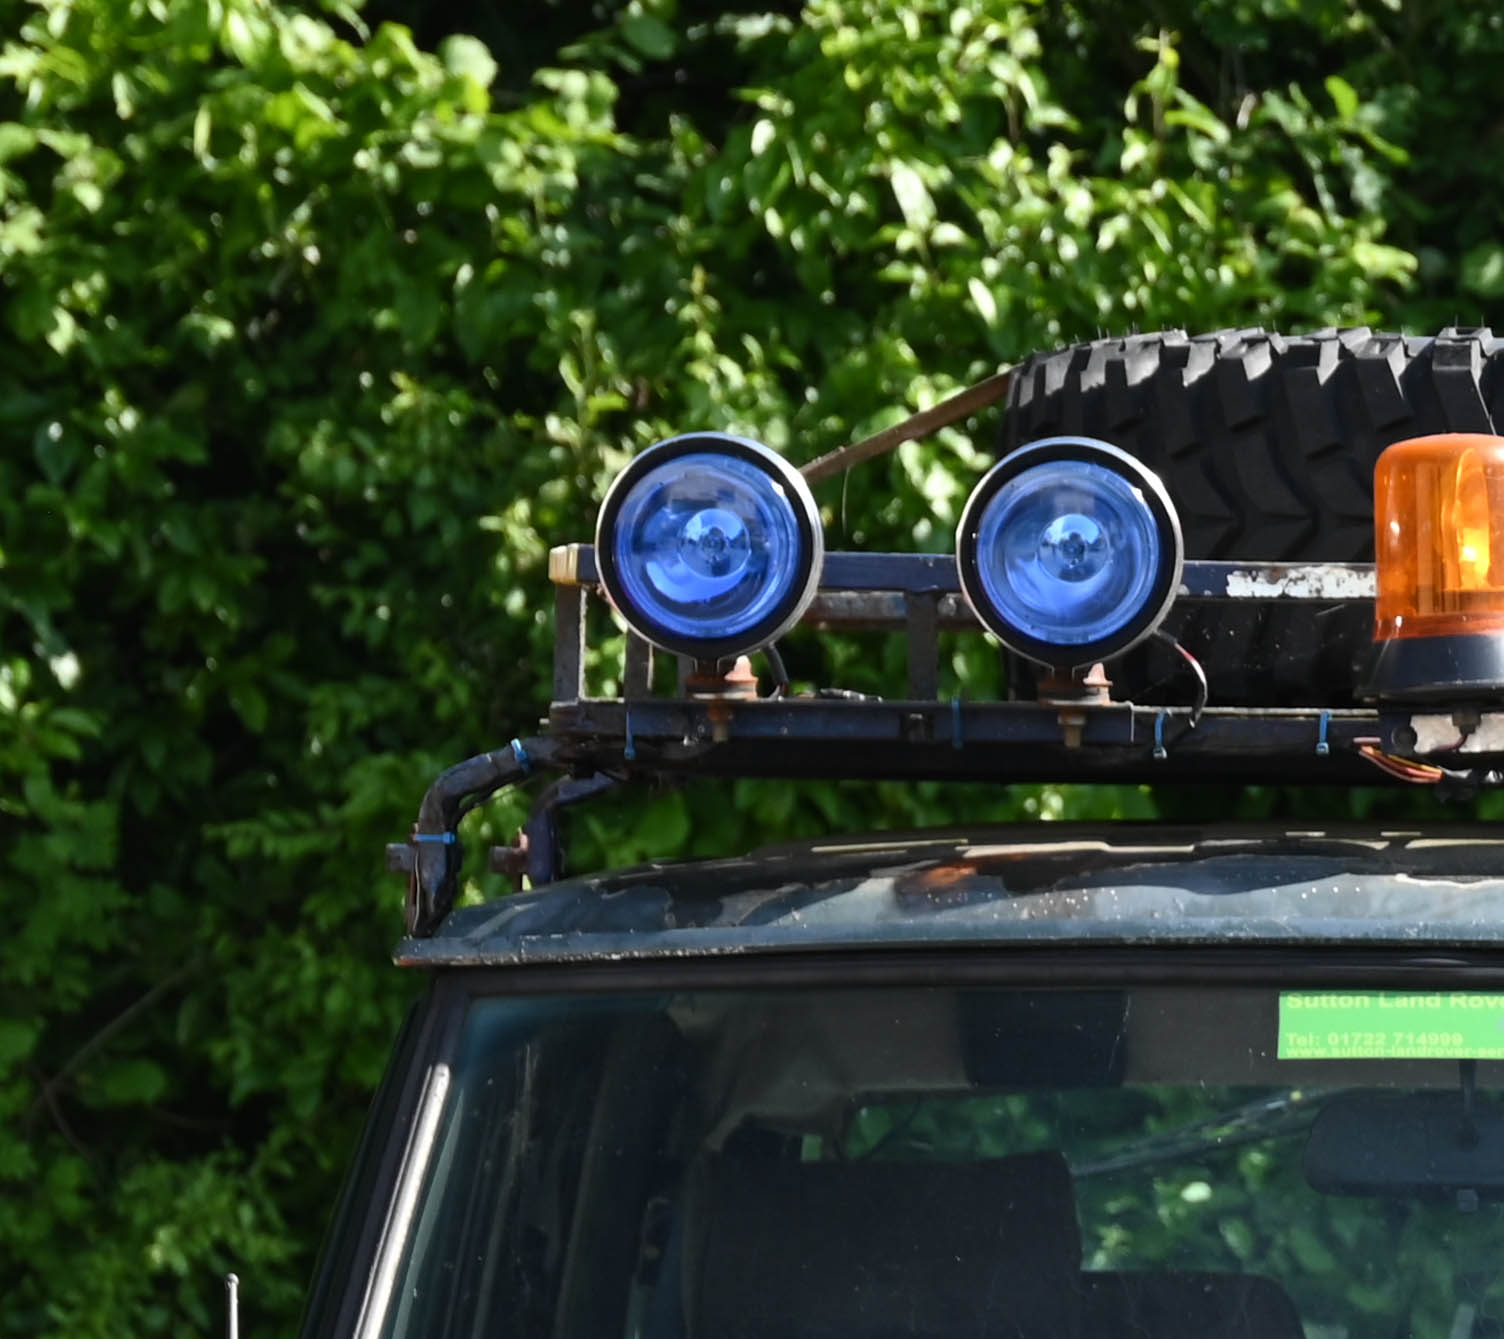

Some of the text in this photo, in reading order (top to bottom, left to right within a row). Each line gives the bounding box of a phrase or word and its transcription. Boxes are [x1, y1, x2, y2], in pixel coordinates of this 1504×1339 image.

[1286, 993, 1370, 1009] Sutton
[1379, 992, 1440, 1009] Land
[1286, 1032, 1319, 1046] Tel:
